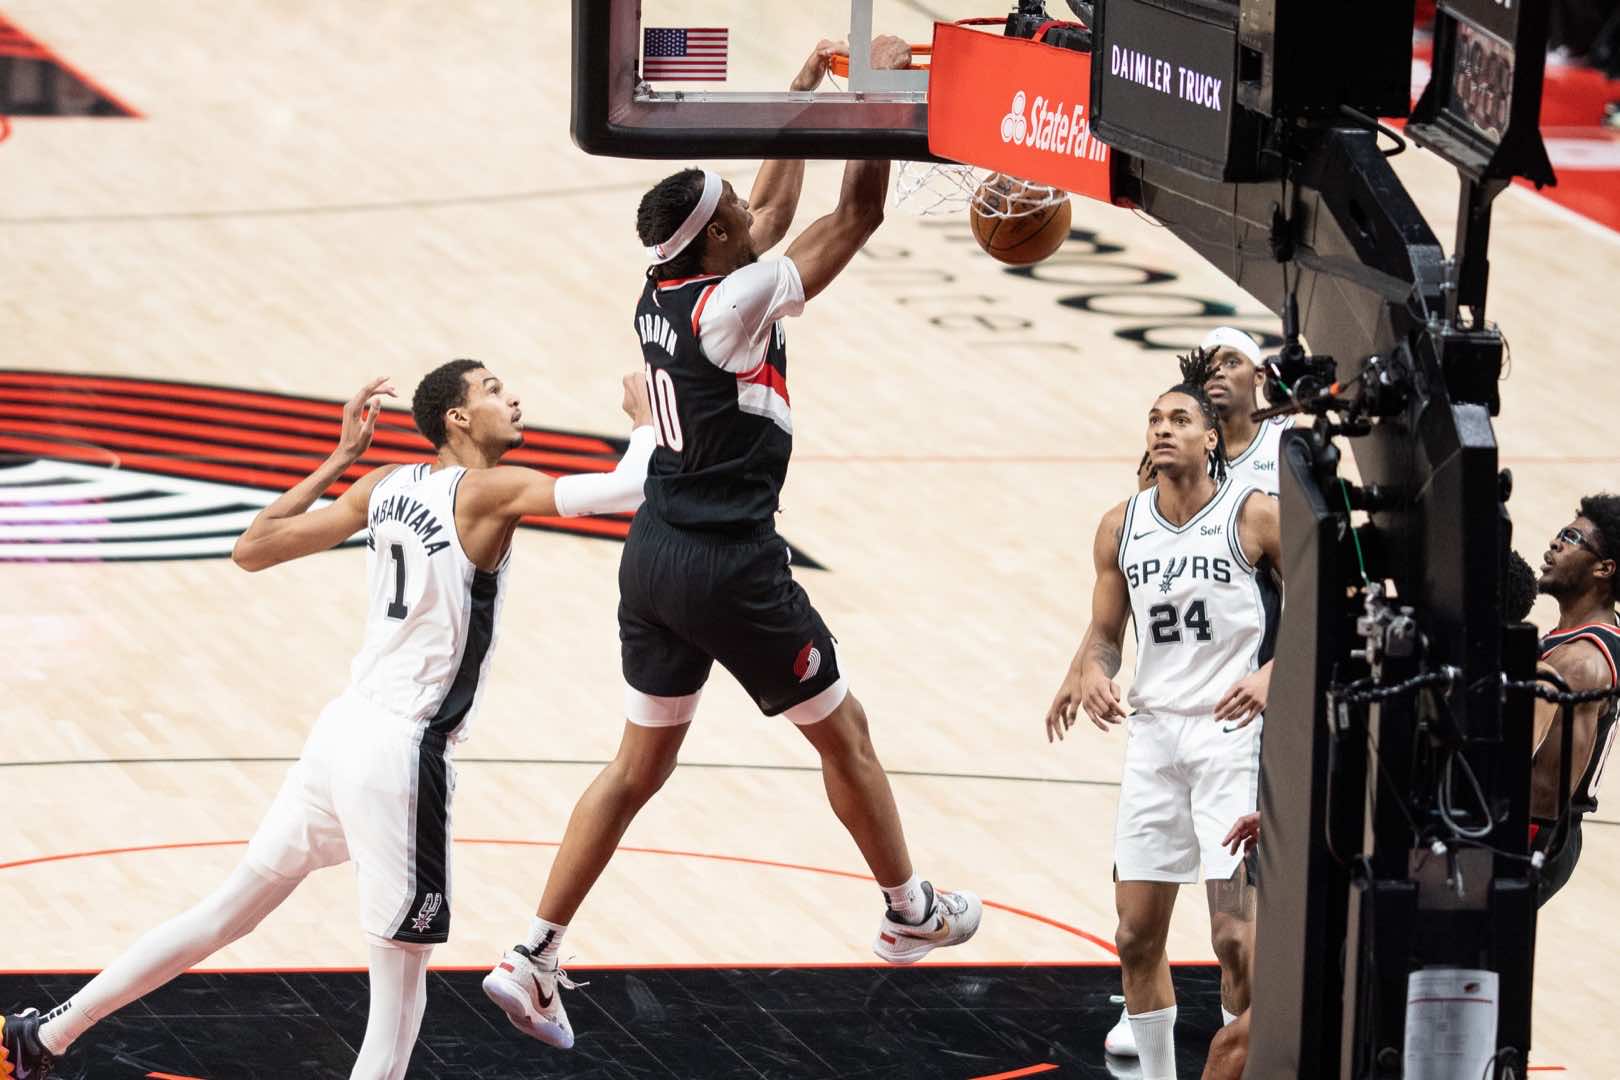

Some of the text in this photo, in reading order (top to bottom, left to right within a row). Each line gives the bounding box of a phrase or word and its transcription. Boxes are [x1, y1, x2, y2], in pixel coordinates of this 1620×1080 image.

[1111, 44, 1222, 111] DAIMLER TRUCK
[638, 313, 678, 357] BROWN
[645, 361, 684, 453] 10
[1200, 524, 1223, 536] Self.
[386, 543, 408, 620] 1
[1126, 555, 1231, 594] SPURS
[1149, 599, 1213, 645] 24
